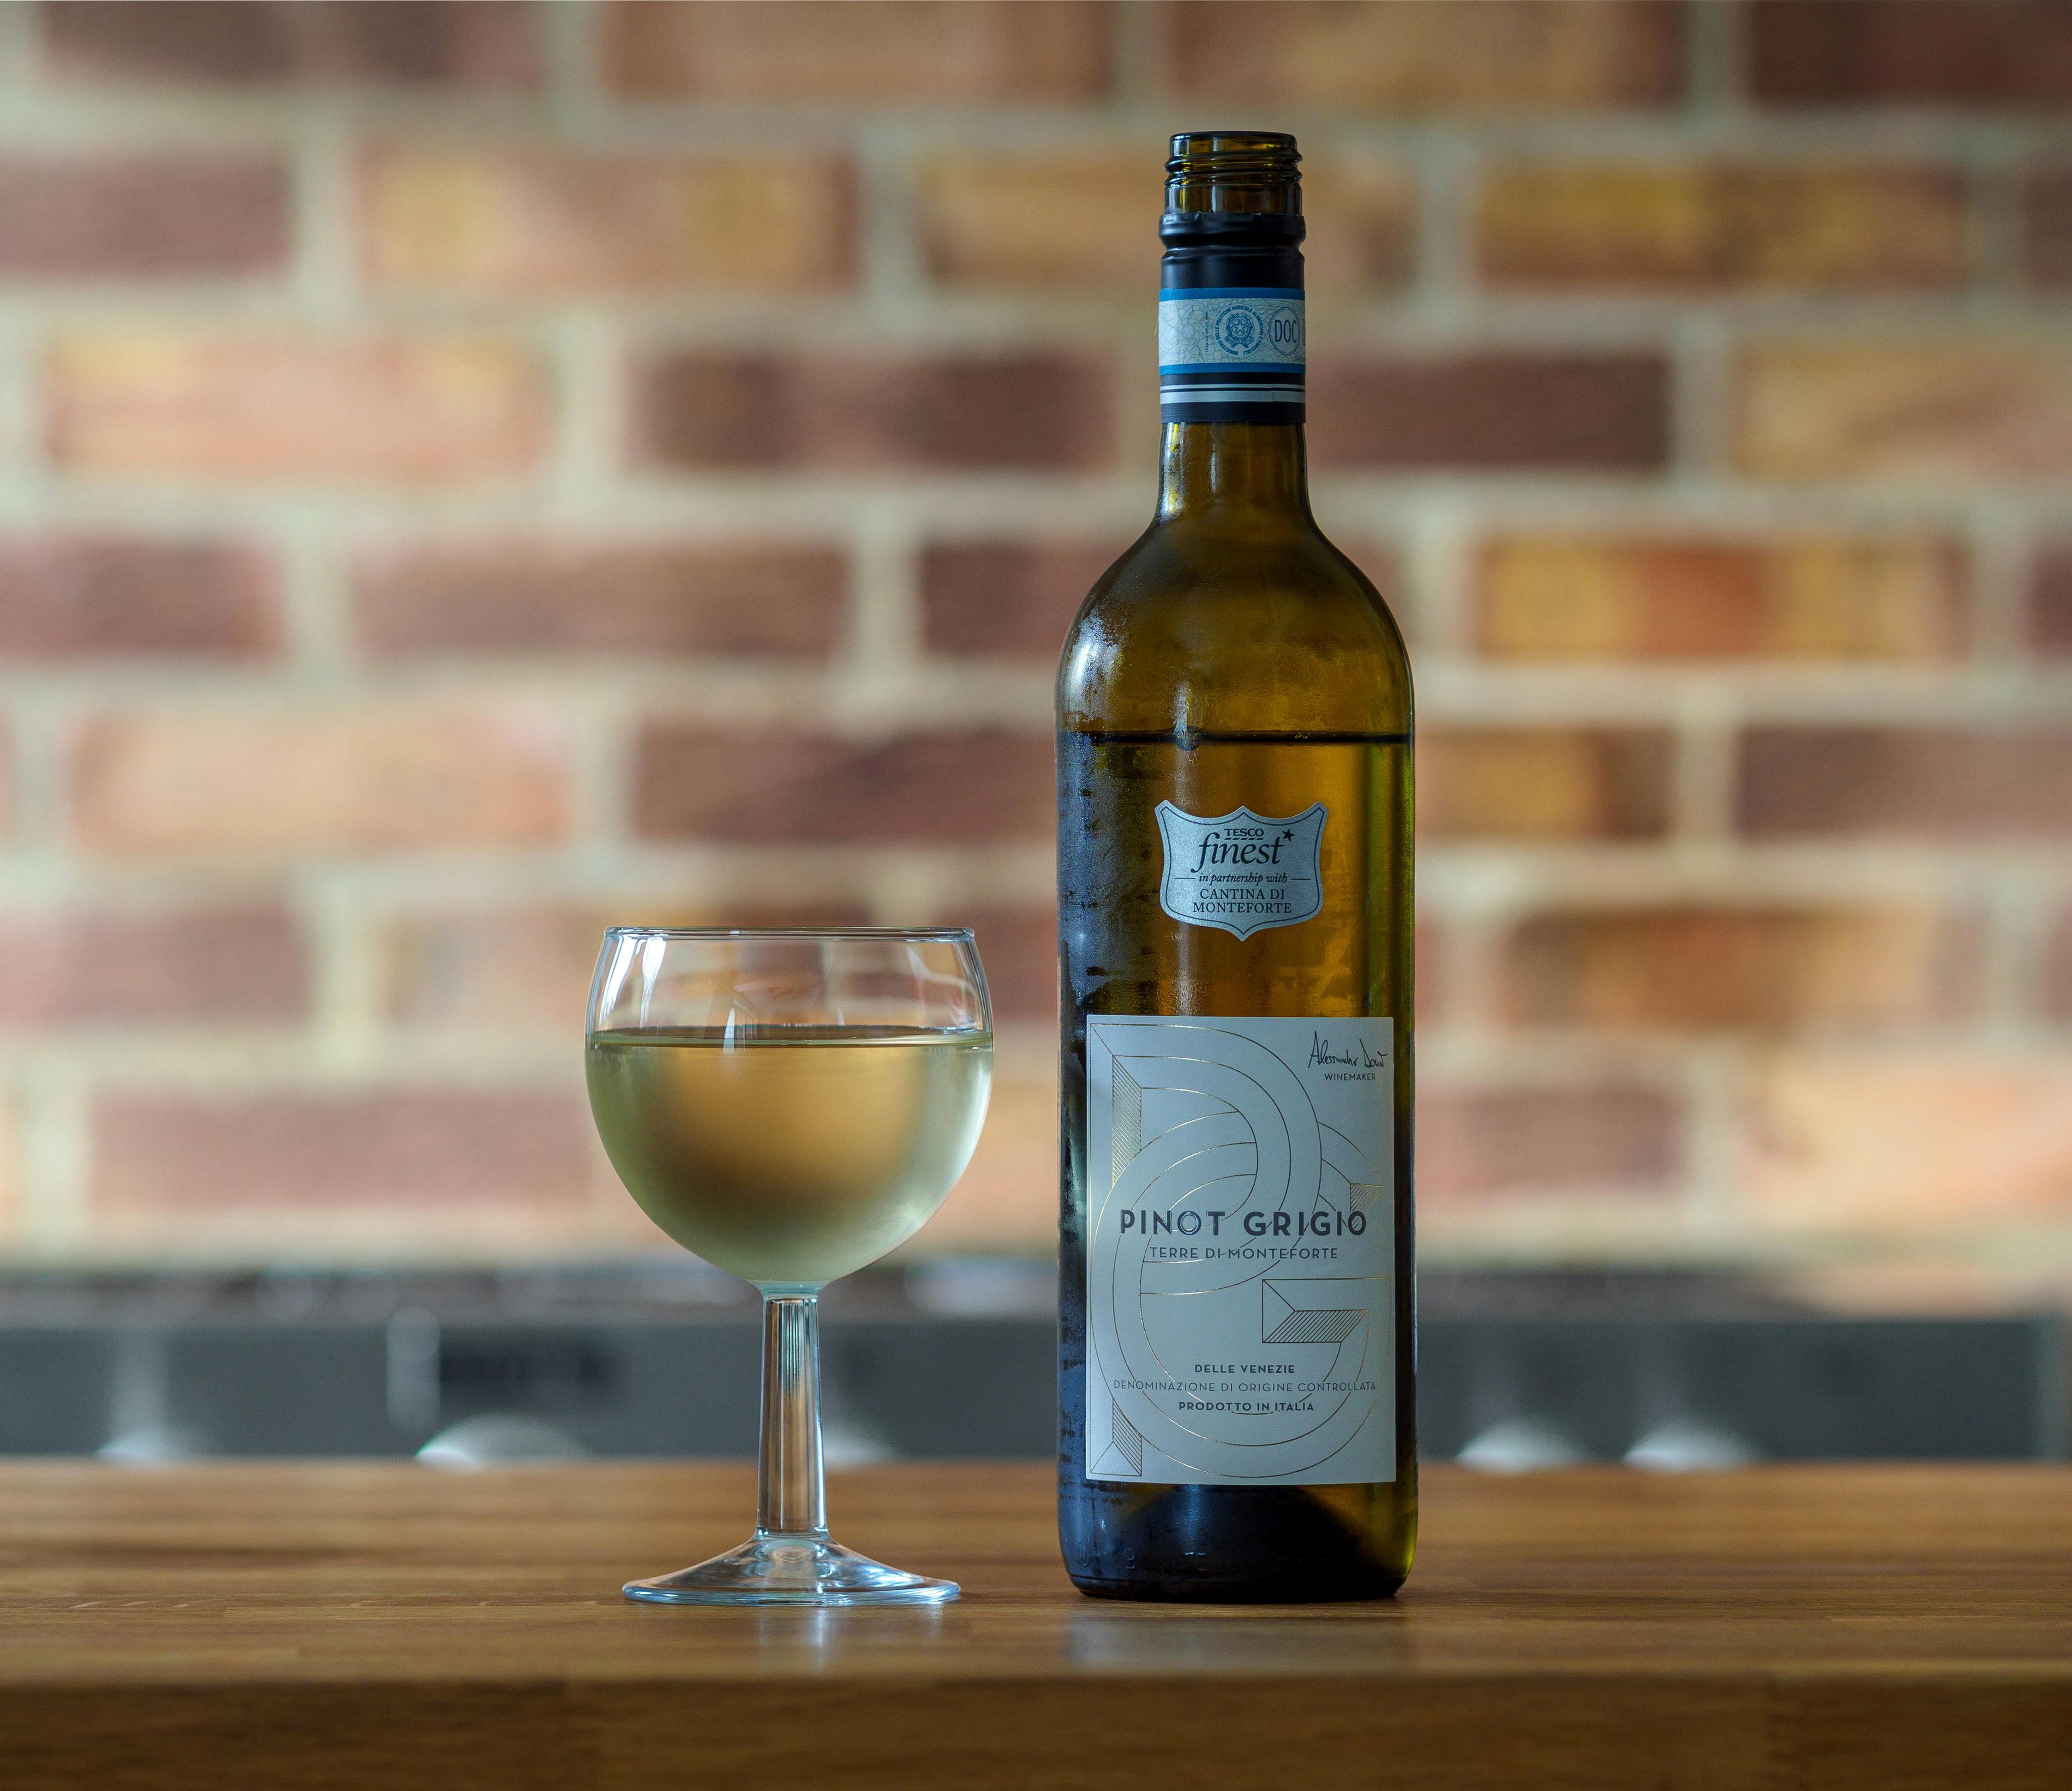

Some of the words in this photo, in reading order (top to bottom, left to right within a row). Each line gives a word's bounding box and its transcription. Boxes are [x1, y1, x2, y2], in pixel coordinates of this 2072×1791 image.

[1215, 307, 1231, 325] POLITICHE
[1242, 339, 1262, 355] FORESTALI
[1274, 319, 1297, 343] DOC
[1224, 828, 1264, 837] TESCO
[1191, 832, 1285, 873] finest
[1199, 873, 1209, 882] in
[1209, 873, 1263, 886] partnership
[1265, 873, 1288, 883] with
[1200, 889, 1265, 900] CANTINA
[1270, 889, 1285, 900] DI
[1192, 902, 1292, 913] MONTEFORTE
[1120, 1209, 1226, 1236] PINOT
[1243, 1210, 1367, 1237] GRIGIO
[1149, 1247, 1198, 1258] TERRE
[1206, 1248, 1221, 1259] DI
[1229, 1247, 1338, 1259] MONTEFORTE
[1195, 1364, 1235, 1374] DELLE
[1240, 1364, 1295, 1374] VENEZIE
[1113, 1380, 1216, 1392] DENOMINAZIONE
[1221, 1383, 1234, 1392] DI
[1240, 1382, 1293, 1392] ORIGINE
[1297, 1381, 1376, 1392] CONTROLLATA
[1179, 1402, 1251, 1411] PRODOTTO
[1257, 1402, 1270, 1411] IN
[1275, 1402, 1314, 1411] ITALIA
